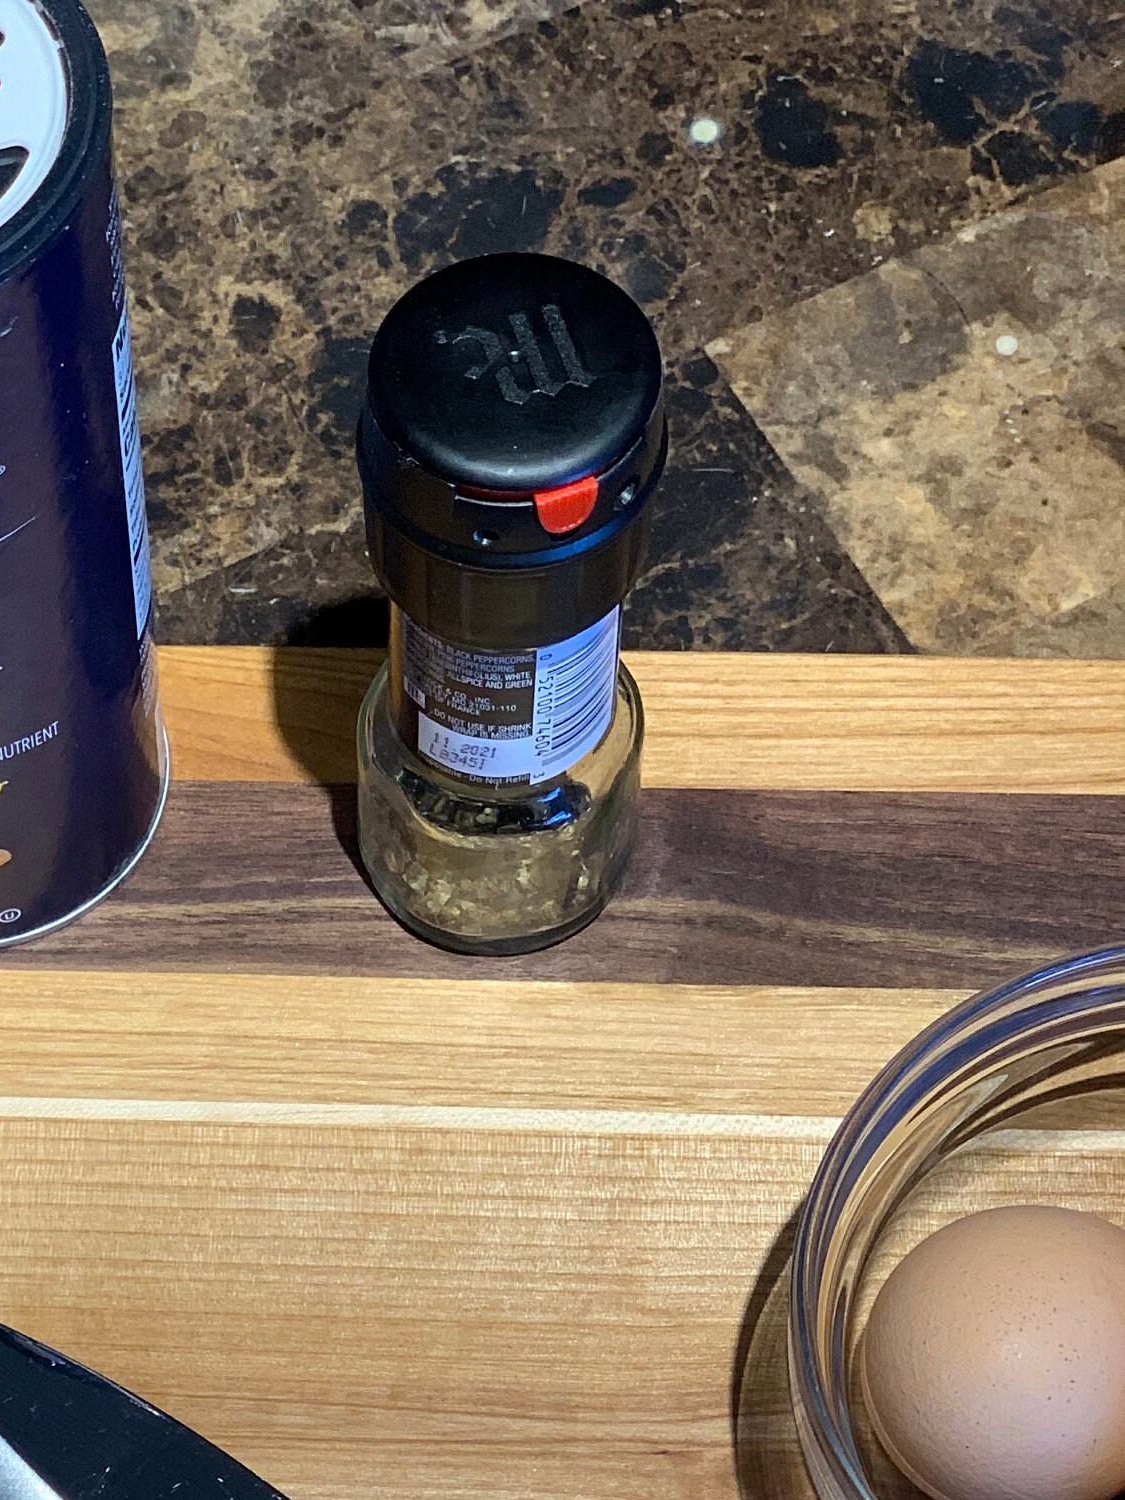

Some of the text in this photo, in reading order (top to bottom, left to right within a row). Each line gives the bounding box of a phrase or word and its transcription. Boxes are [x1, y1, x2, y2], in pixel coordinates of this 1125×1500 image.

[446, 671, 532, 689] ALLSPICE AND GREEN
[504, 671, 531, 680] WHITE
[446, 698, 481, 716] FRANCE
[533, 653, 554, 779] 0 52100 74604 3
[434, 707, 532, 734] DO NOT USE IF SHRINK
[452, 725, 477, 738] WRAP
[479, 731, 489, 739] IS
